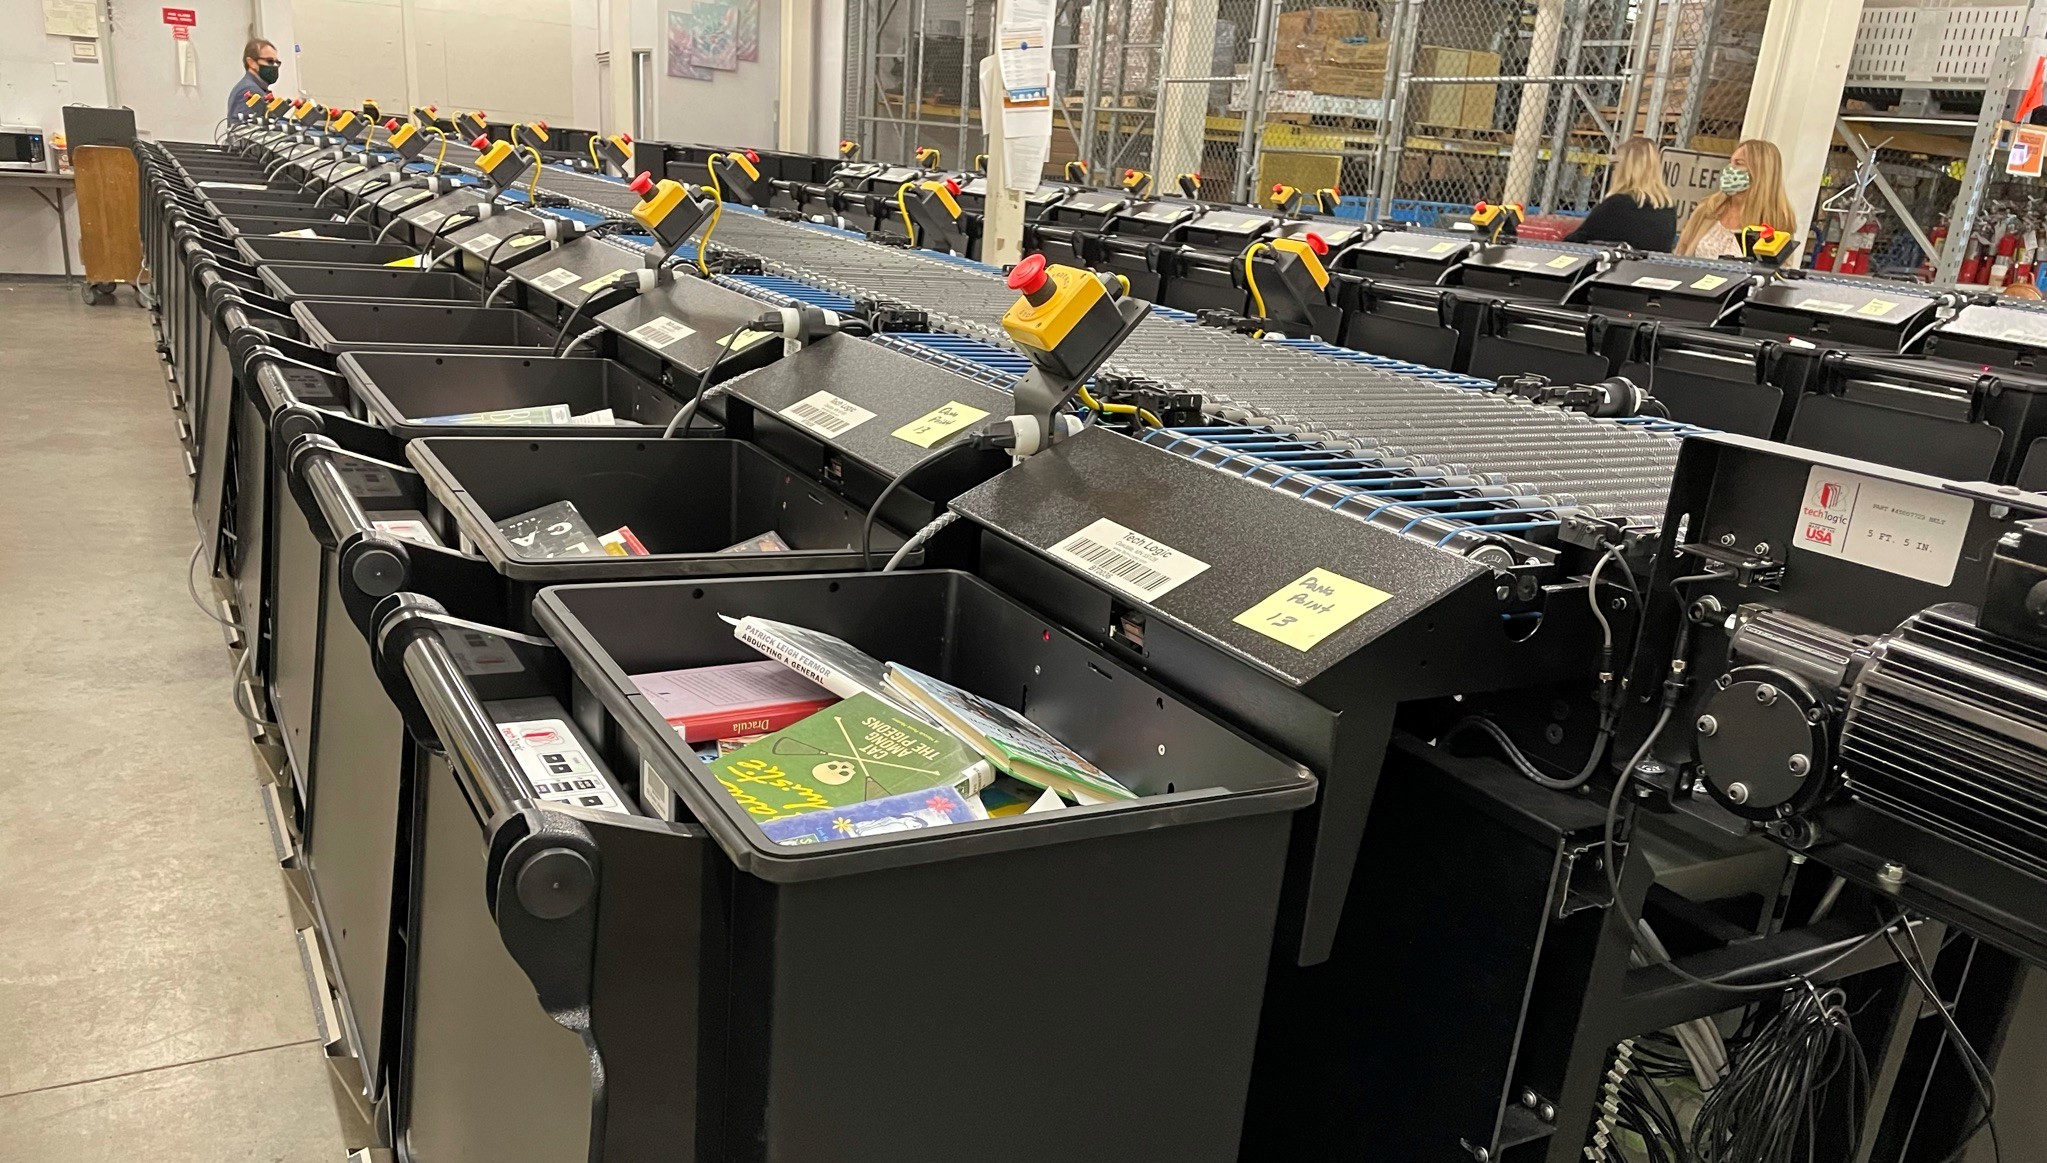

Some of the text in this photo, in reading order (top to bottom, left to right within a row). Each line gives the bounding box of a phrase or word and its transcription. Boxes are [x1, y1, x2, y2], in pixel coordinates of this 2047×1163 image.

[1663, 161, 1720, 190] NO LEF
[1123, 531, 1172, 559] Tech Logic
[1805, 527, 1832, 544] USA
[1867, 529, 1933, 553] 5 FT. 5 IN.
[1266, 612, 1298, 627] 13
[741, 633, 782, 662] ABDUCTING
[791, 661, 825, 685] GENERAL
[745, 624, 831, 678] PATRICK LEIGH FERMOR
[732, 718, 769, 733] Dracula
[861, 715, 917, 748] PIGEONS
[859, 743, 889, 760] CAT
[864, 731, 912, 758] AMONG
[912, 740, 940, 761] THE
